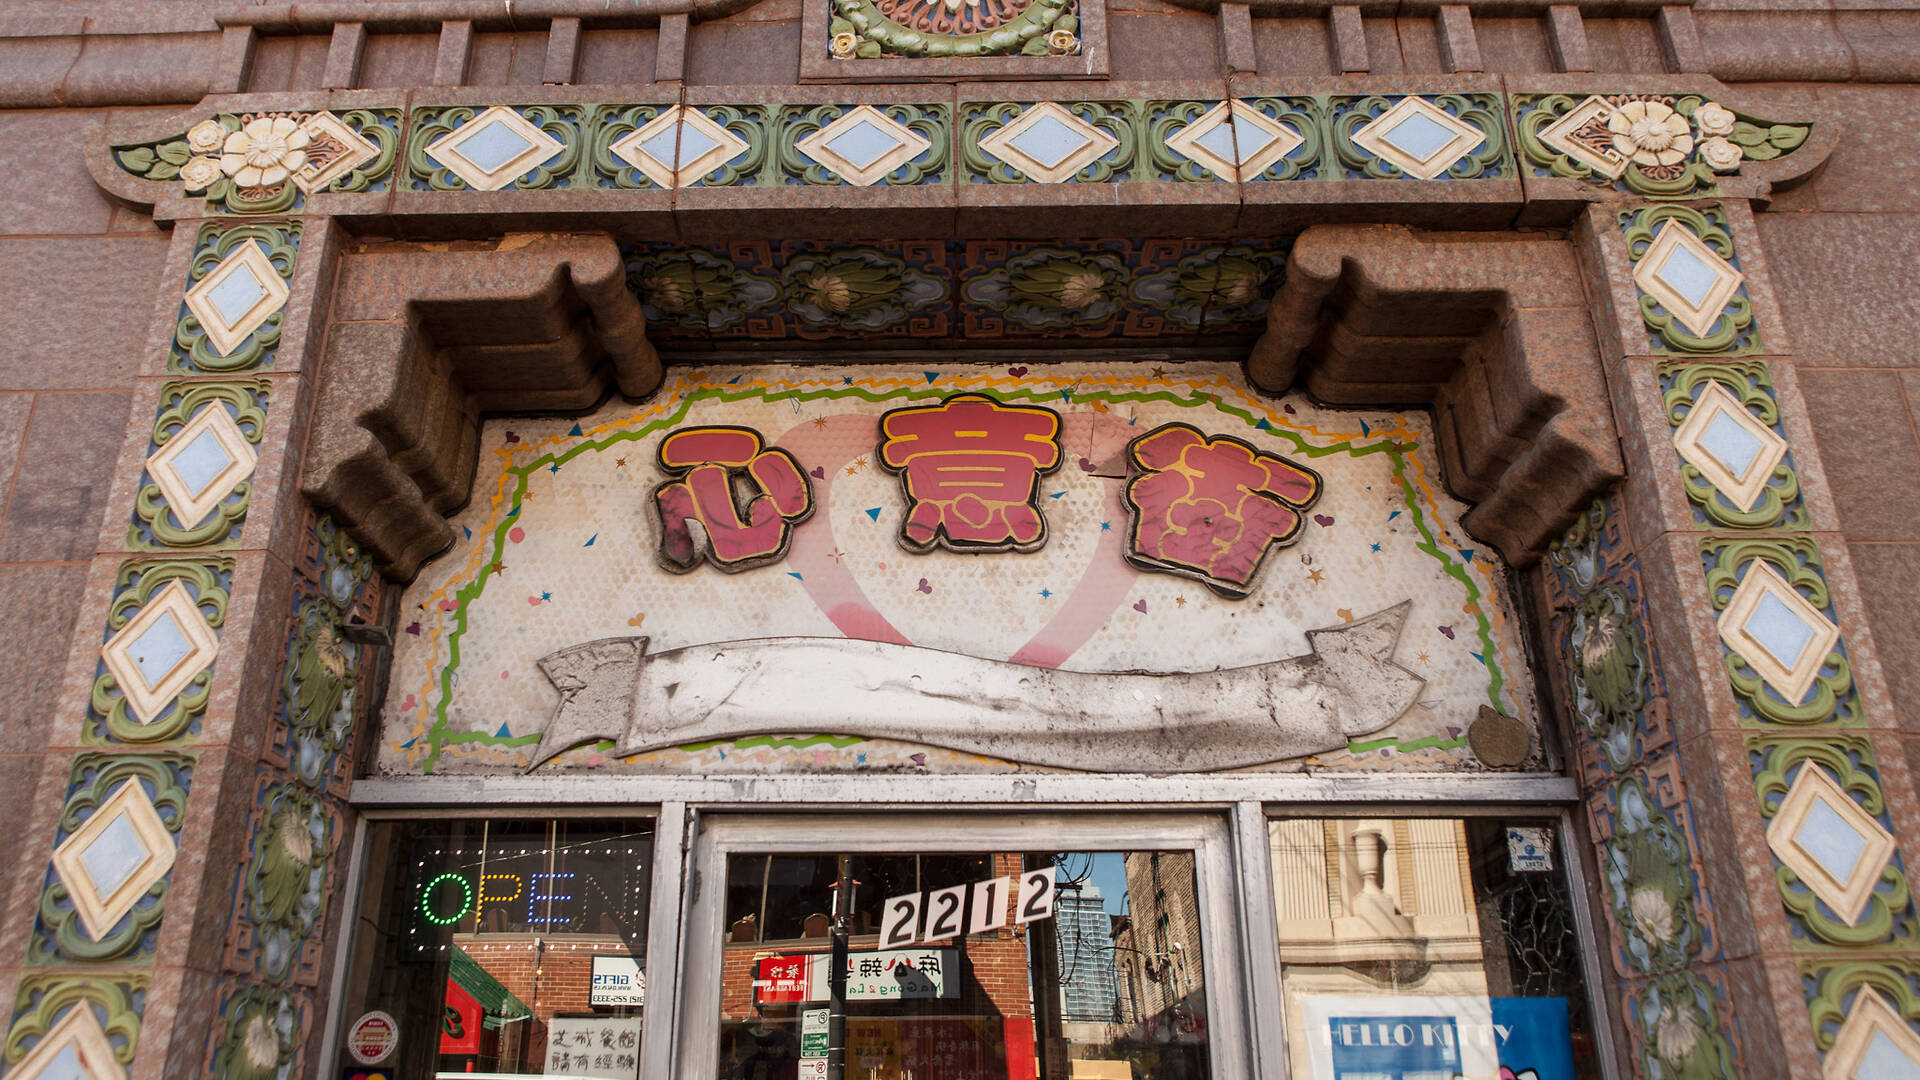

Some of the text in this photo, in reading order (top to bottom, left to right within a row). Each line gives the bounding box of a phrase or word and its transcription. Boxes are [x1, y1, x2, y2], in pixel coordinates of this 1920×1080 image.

[421, 872, 633, 925] OPEN
[887, 873, 1050, 945] 2212
[1322, 1023, 1415, 1047] HELLO
